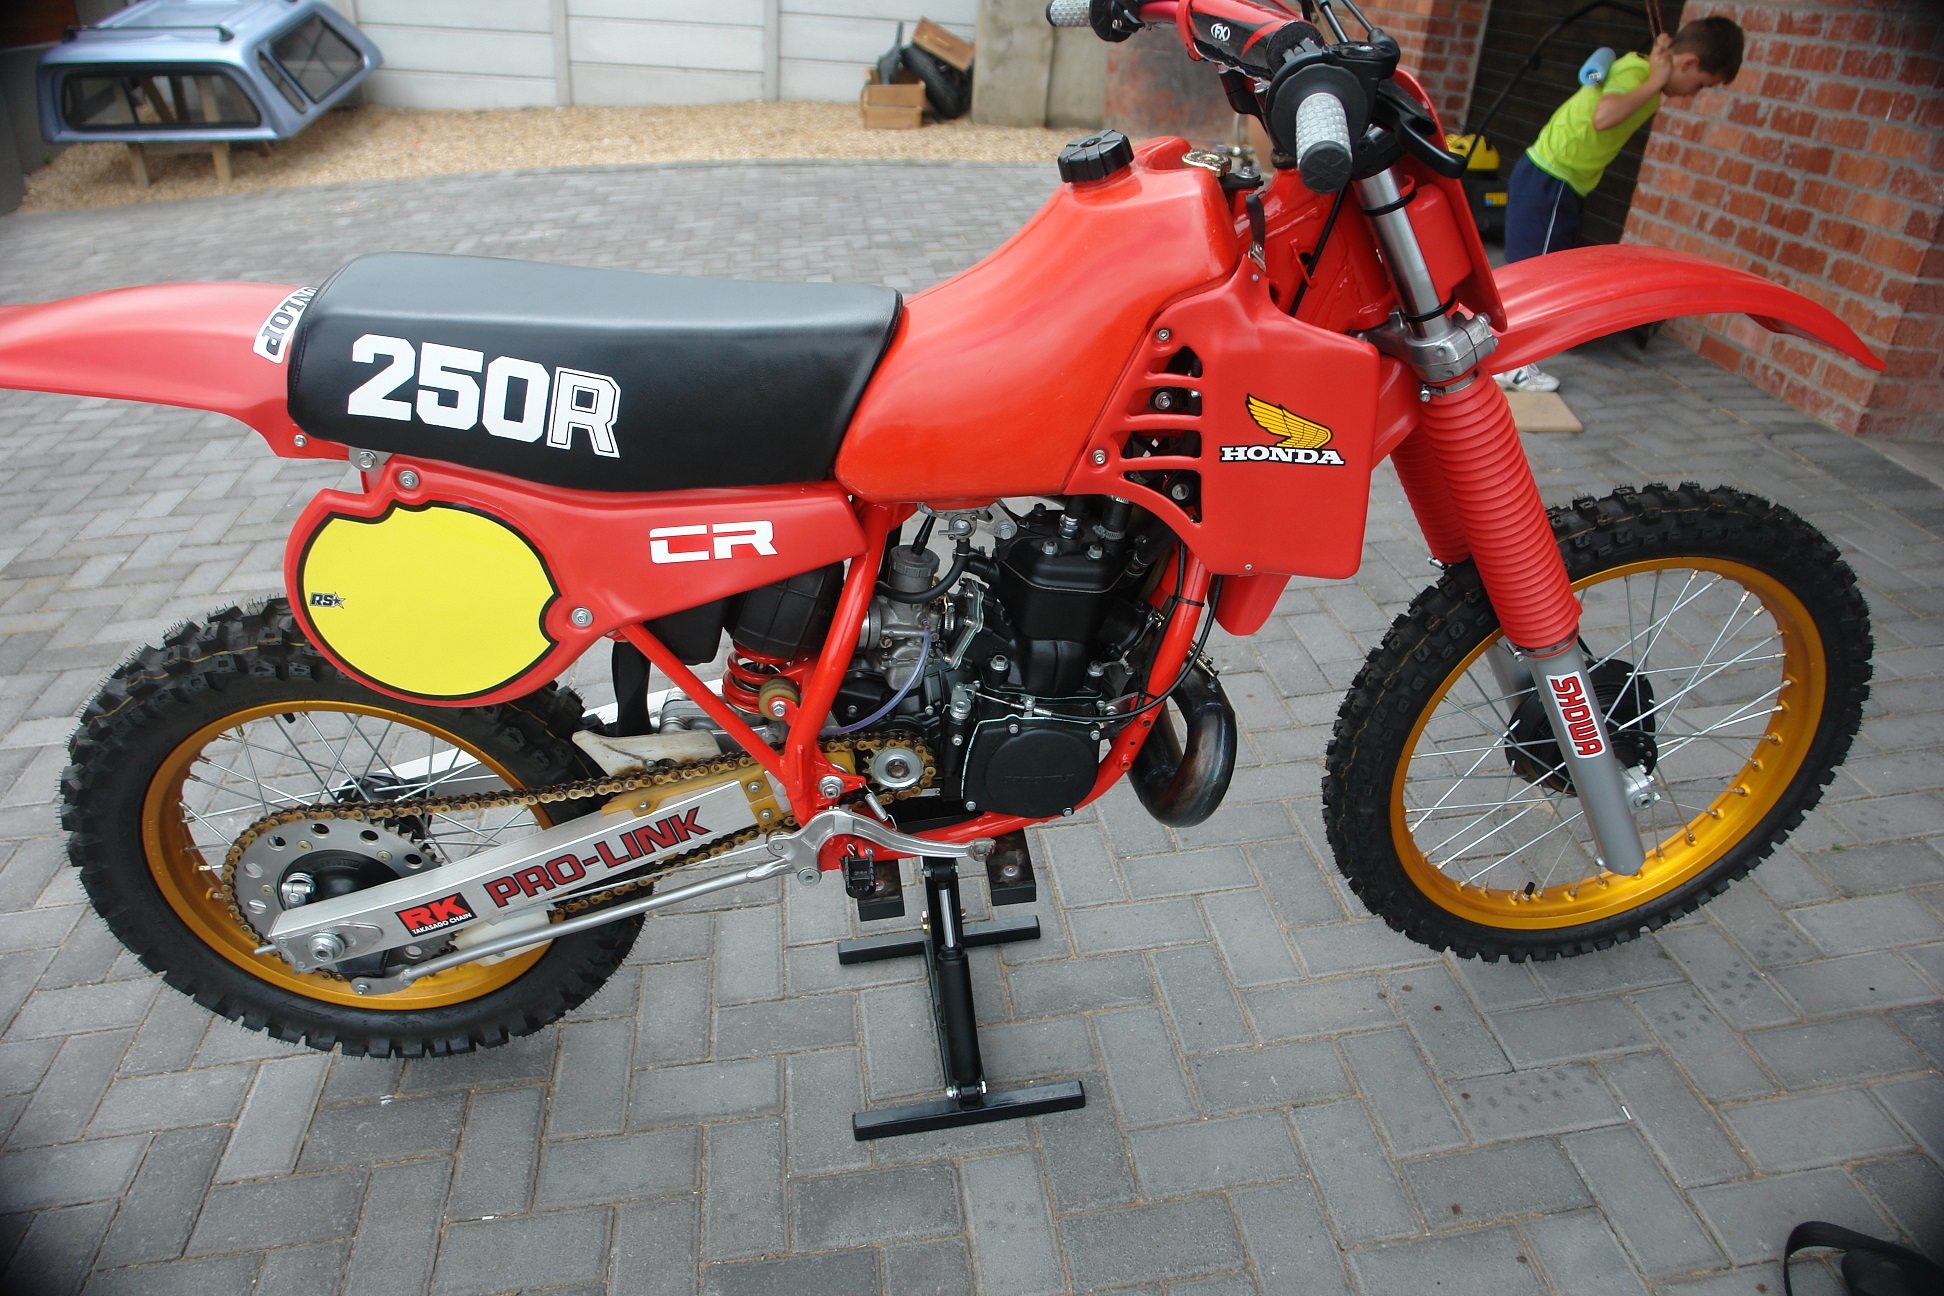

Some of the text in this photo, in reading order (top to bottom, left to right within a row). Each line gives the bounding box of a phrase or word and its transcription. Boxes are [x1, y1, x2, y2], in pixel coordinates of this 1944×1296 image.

[262, 286, 318, 356] UNLOP
[348, 333, 621, 458] 250R
[1221, 446, 1344, 465] HONDA
[650, 520, 778, 564] CR
[1550, 676, 1603, 755] SHOWA
[482, 805, 712, 908] PRO-LINK
[398, 895, 469, 931] RK
[411, 912, 473, 935] TAKASAGO CHAIN
